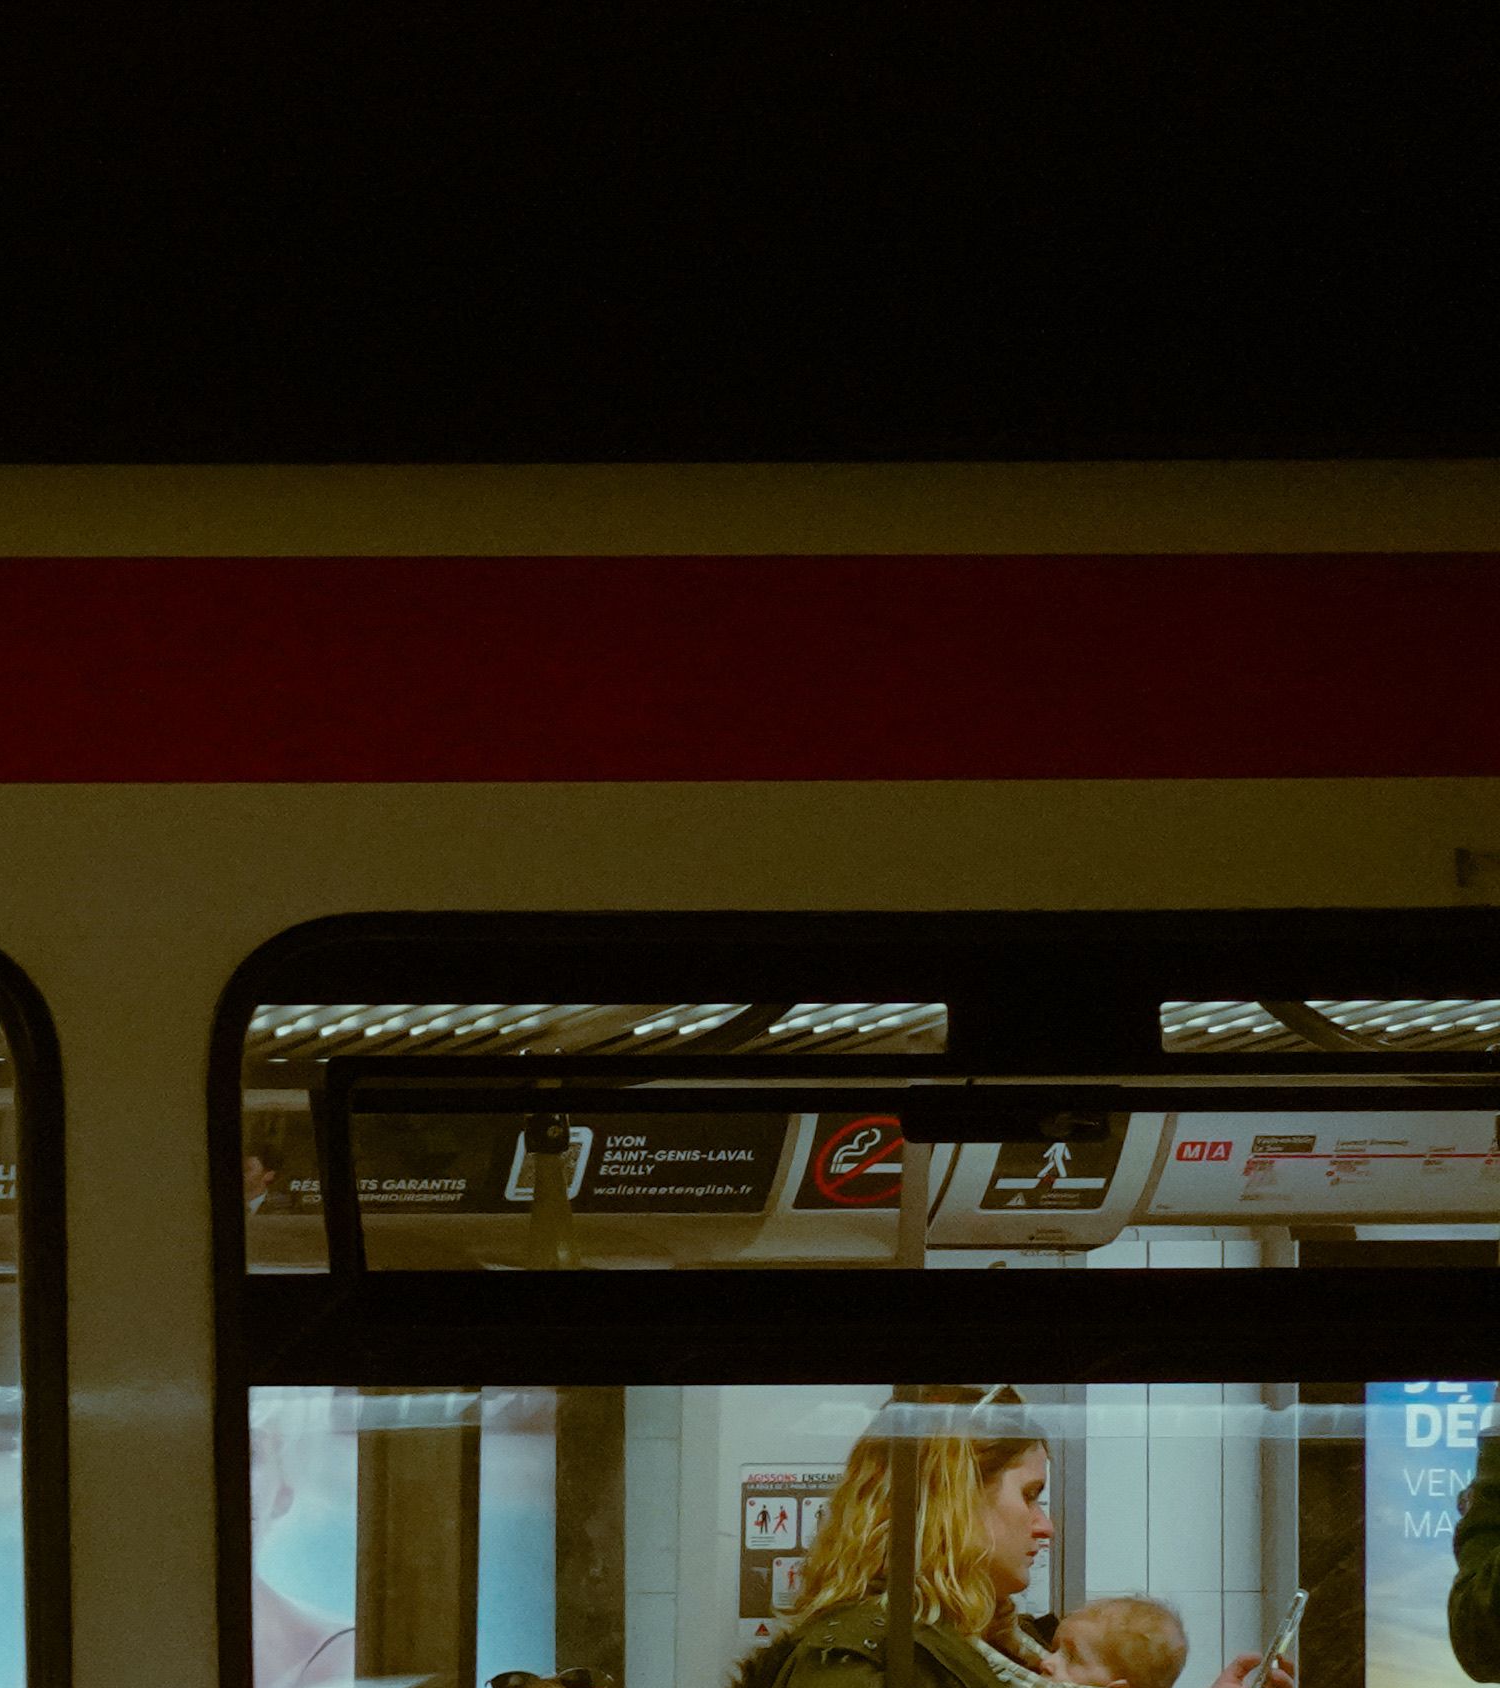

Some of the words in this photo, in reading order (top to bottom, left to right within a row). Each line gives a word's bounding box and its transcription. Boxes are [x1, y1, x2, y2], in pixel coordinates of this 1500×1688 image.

[606, 1136, 647, 1147] LYON
[603, 1150, 755, 1162] SAINT-GENIS-LAVAL
[1183, 1145, 1202, 1160] M
[1210, 1145, 1227, 1160] A
[600, 1164, 656, 1176] ECULLY
[382, 1179, 467, 1191] GARANTIS
[592, 1184, 754, 1197] wallstreetenglish.fr
